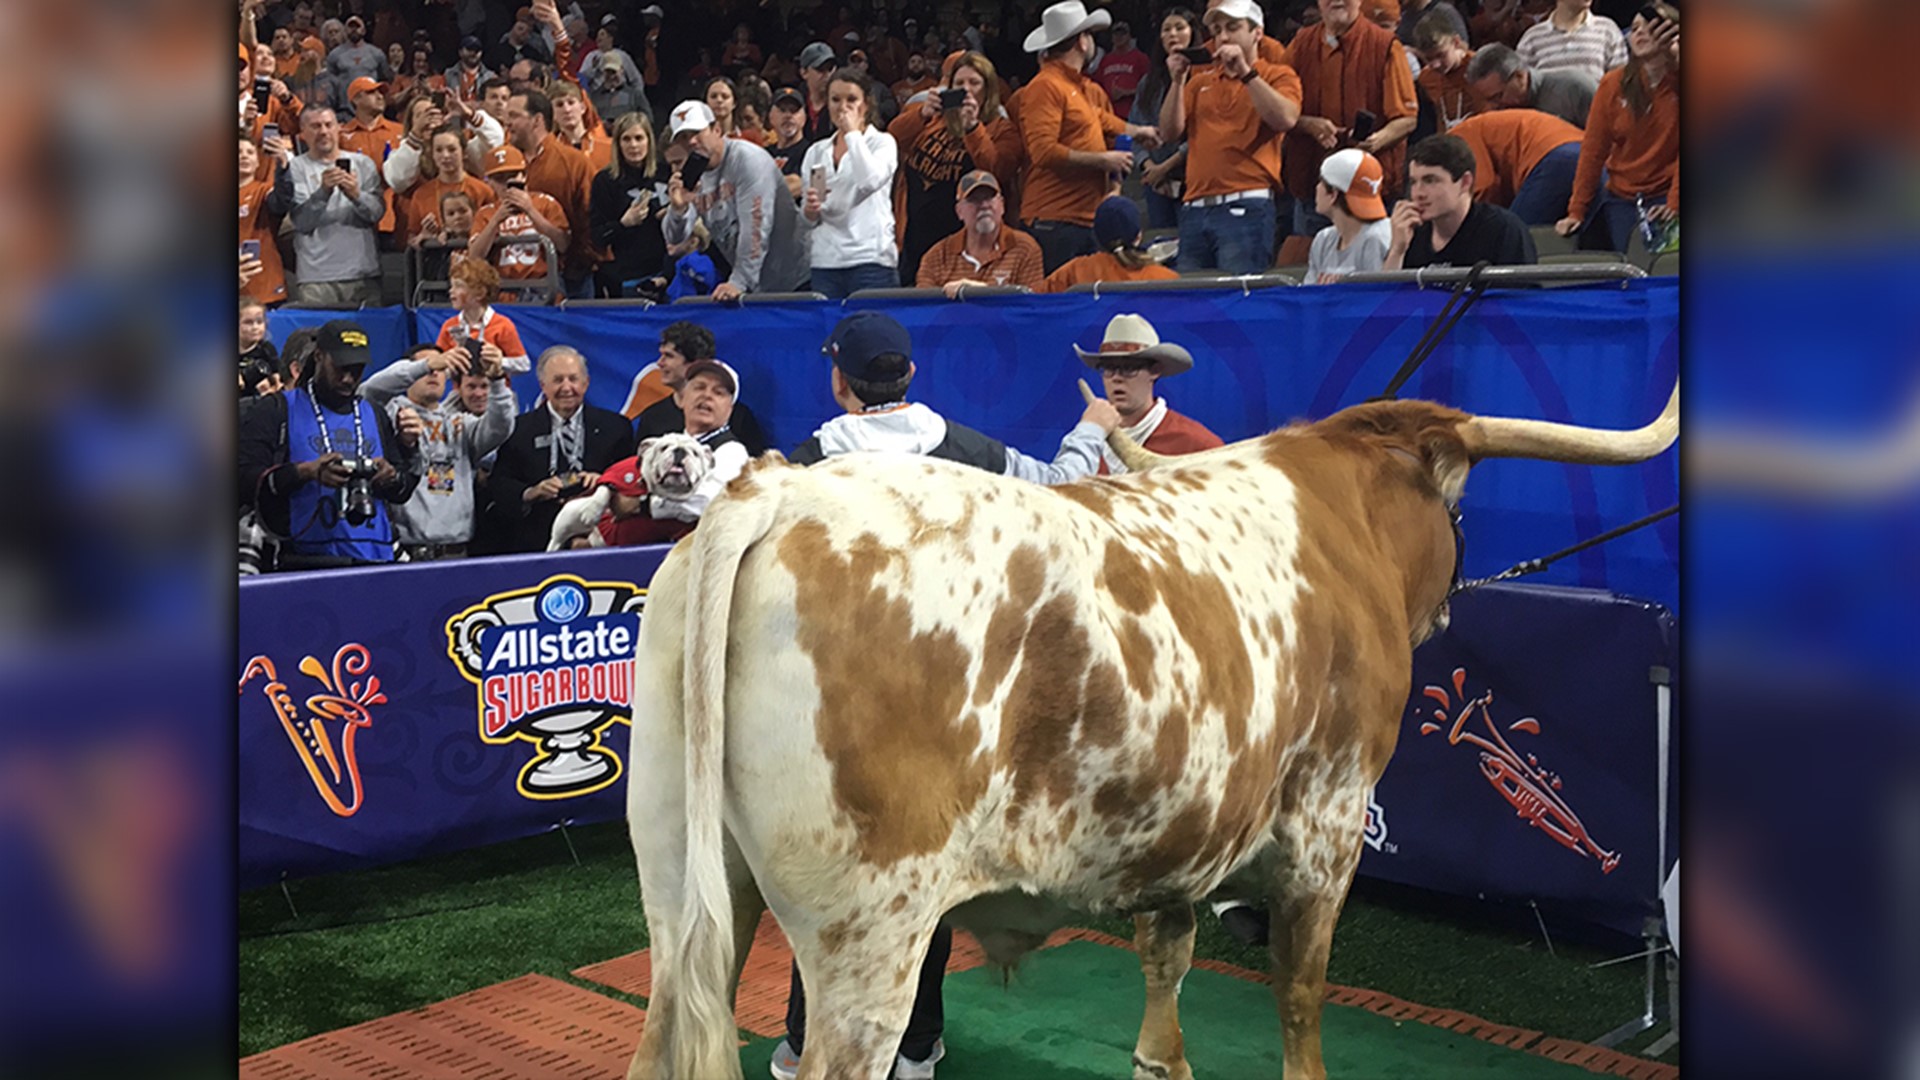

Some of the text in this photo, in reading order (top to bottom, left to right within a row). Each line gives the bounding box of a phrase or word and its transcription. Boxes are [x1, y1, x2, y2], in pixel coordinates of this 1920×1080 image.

[494, 149, 507, 164] T
[486, 620, 630, 671] Allstate
[485, 667, 574, 736] SUGAR
[1384, 841, 1399, 854] TM
